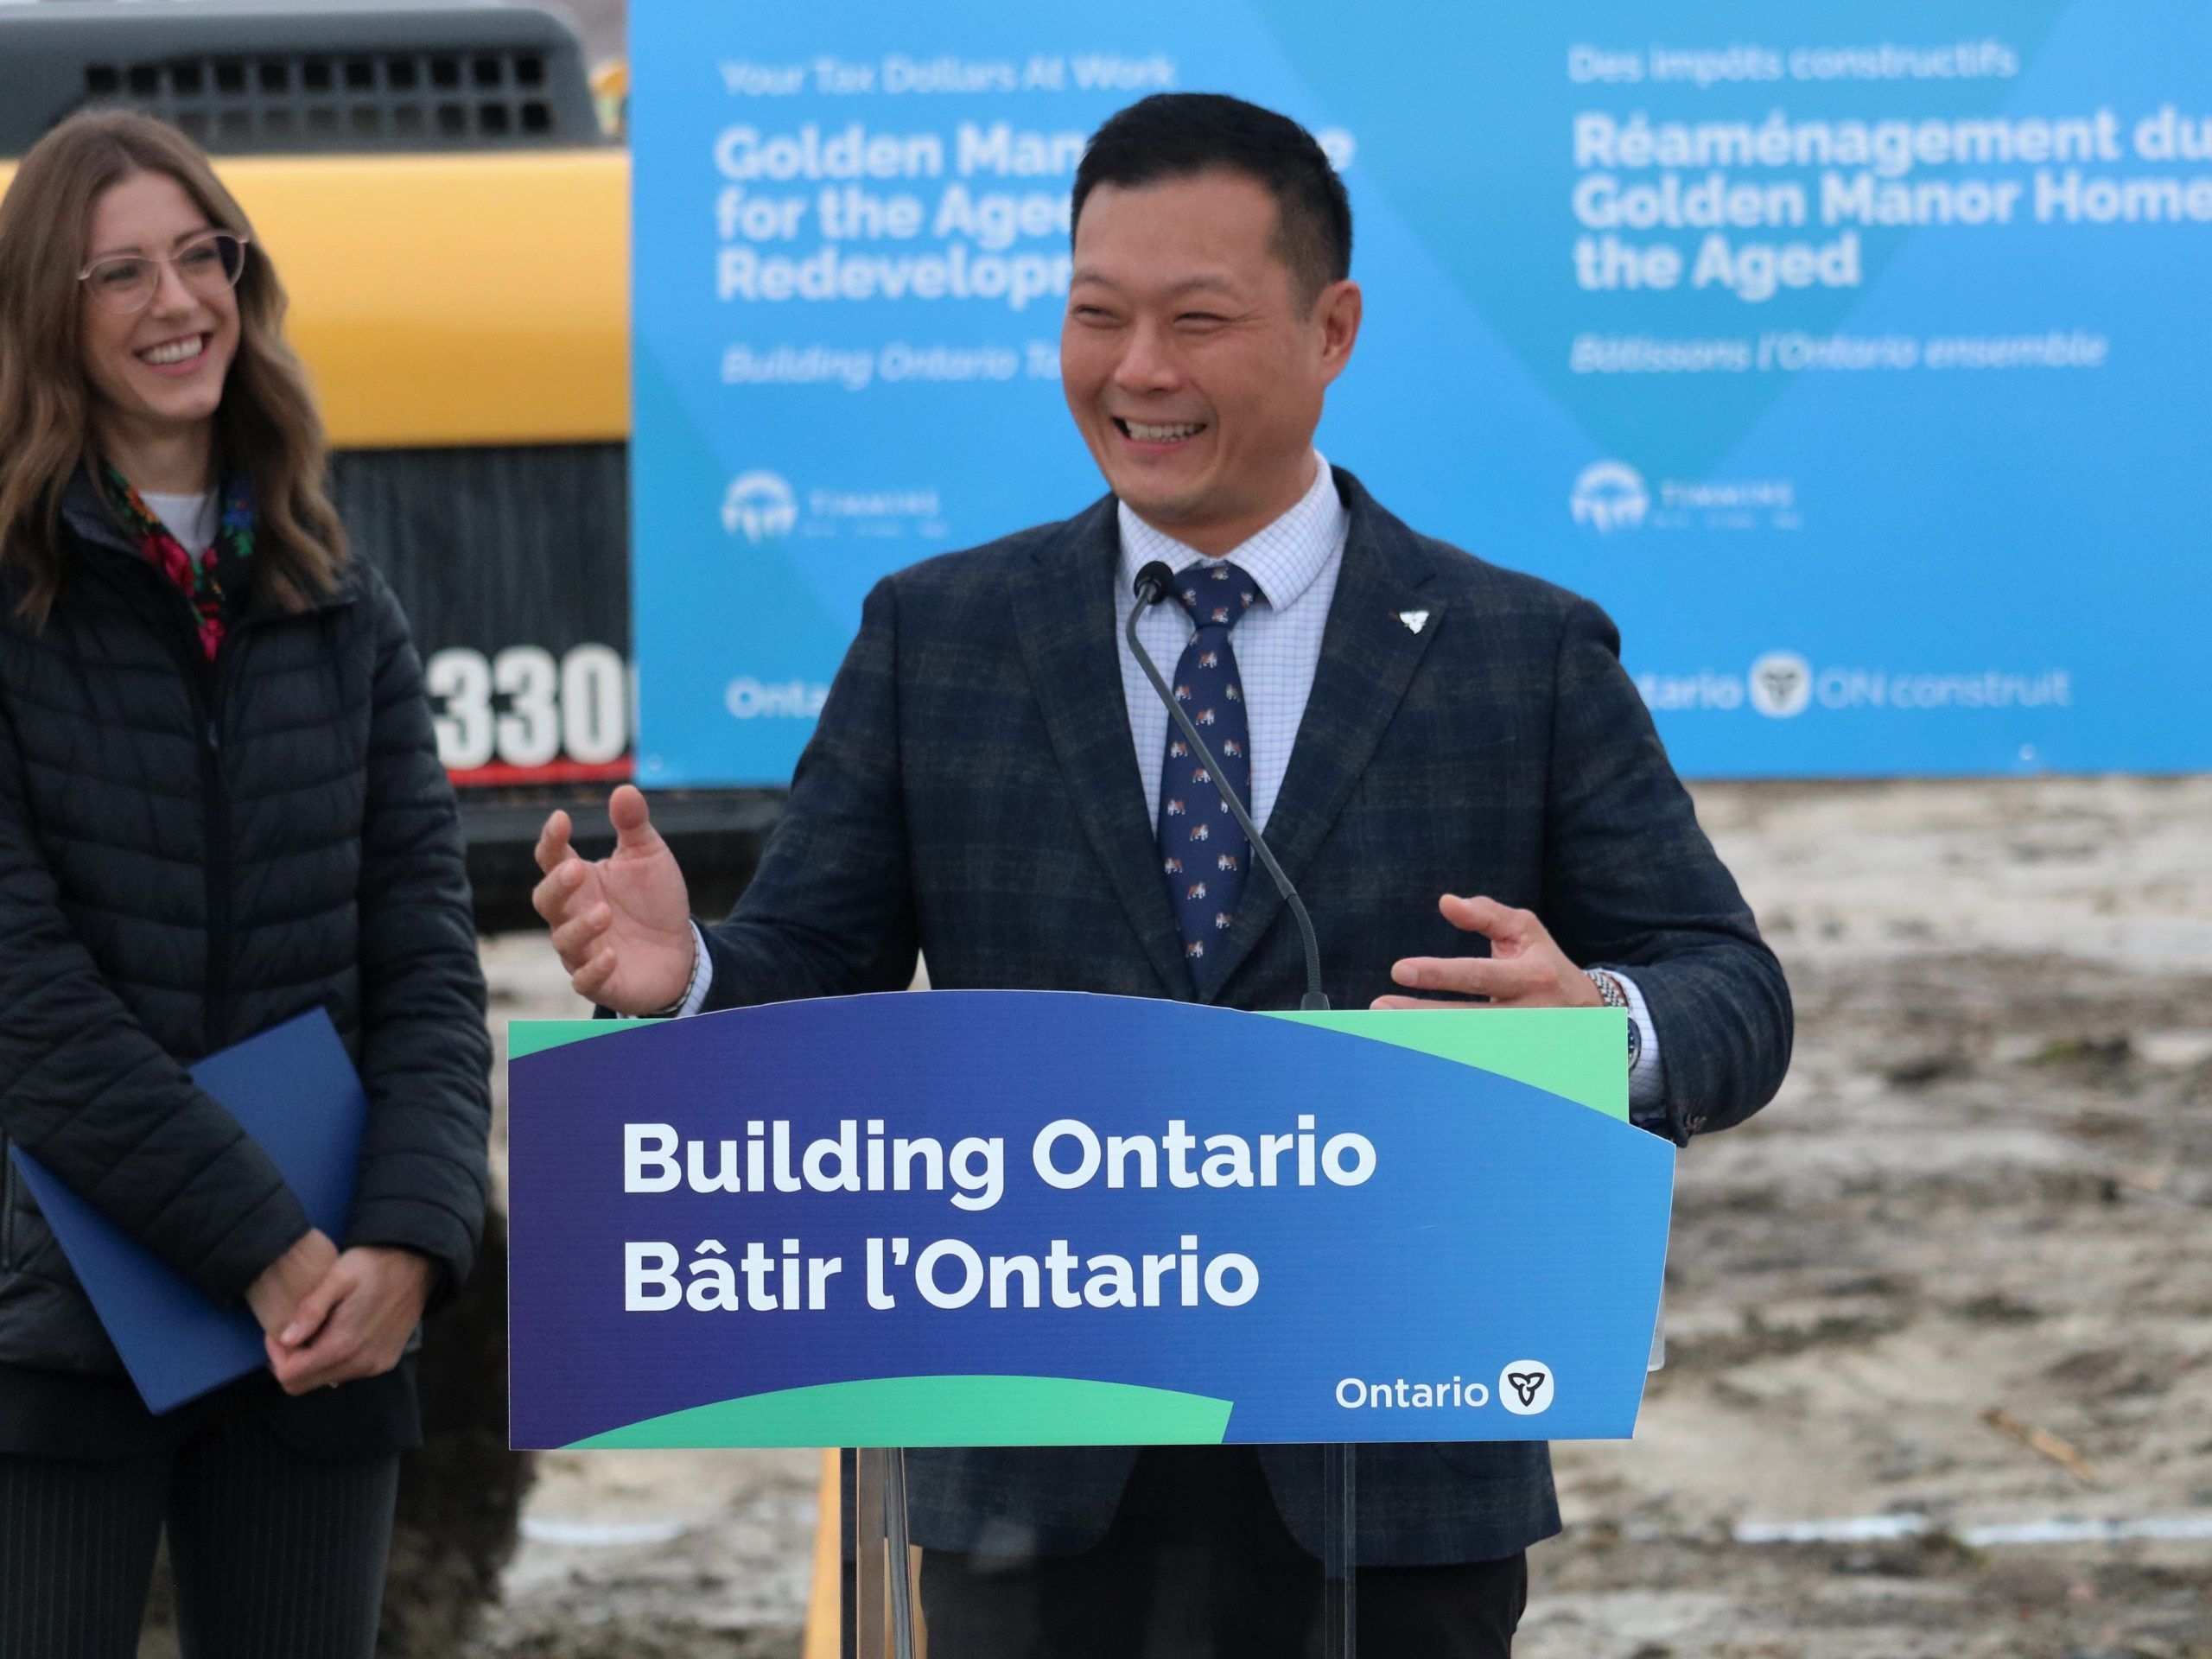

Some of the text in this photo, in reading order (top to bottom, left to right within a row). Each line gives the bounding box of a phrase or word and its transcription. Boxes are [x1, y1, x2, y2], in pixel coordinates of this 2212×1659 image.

[719, 53, 1177, 96] Your Tax Dollars At Work
[1567, 43, 1642, 84] Des
[1787, 37, 2019, 81] constructifs
[713, 122, 1084, 181] Golden Man
[1573, 104, 2212, 178] Réaménagement du
[715, 182, 1072, 249] for the Age
[1572, 168, 2212, 228] Golden Manor Home
[715, 244, 1071, 311] Redevelop
[1573, 229, 1862, 302] the Aged
[720, 341, 871, 391] Building
[876, 342, 1020, 382] Ontario
[1923, 329, 2108, 369] ensemble
[429, 642, 639, 768] 330
[725, 677, 830, 719] Onta
[1636, 671, 1745, 711] tario
[624, 1114, 1376, 1211] Building Ontario
[625, 1235, 1259, 1312] Bâtir l’Ontario
[1336, 1376, 1489, 1408] Ontario
